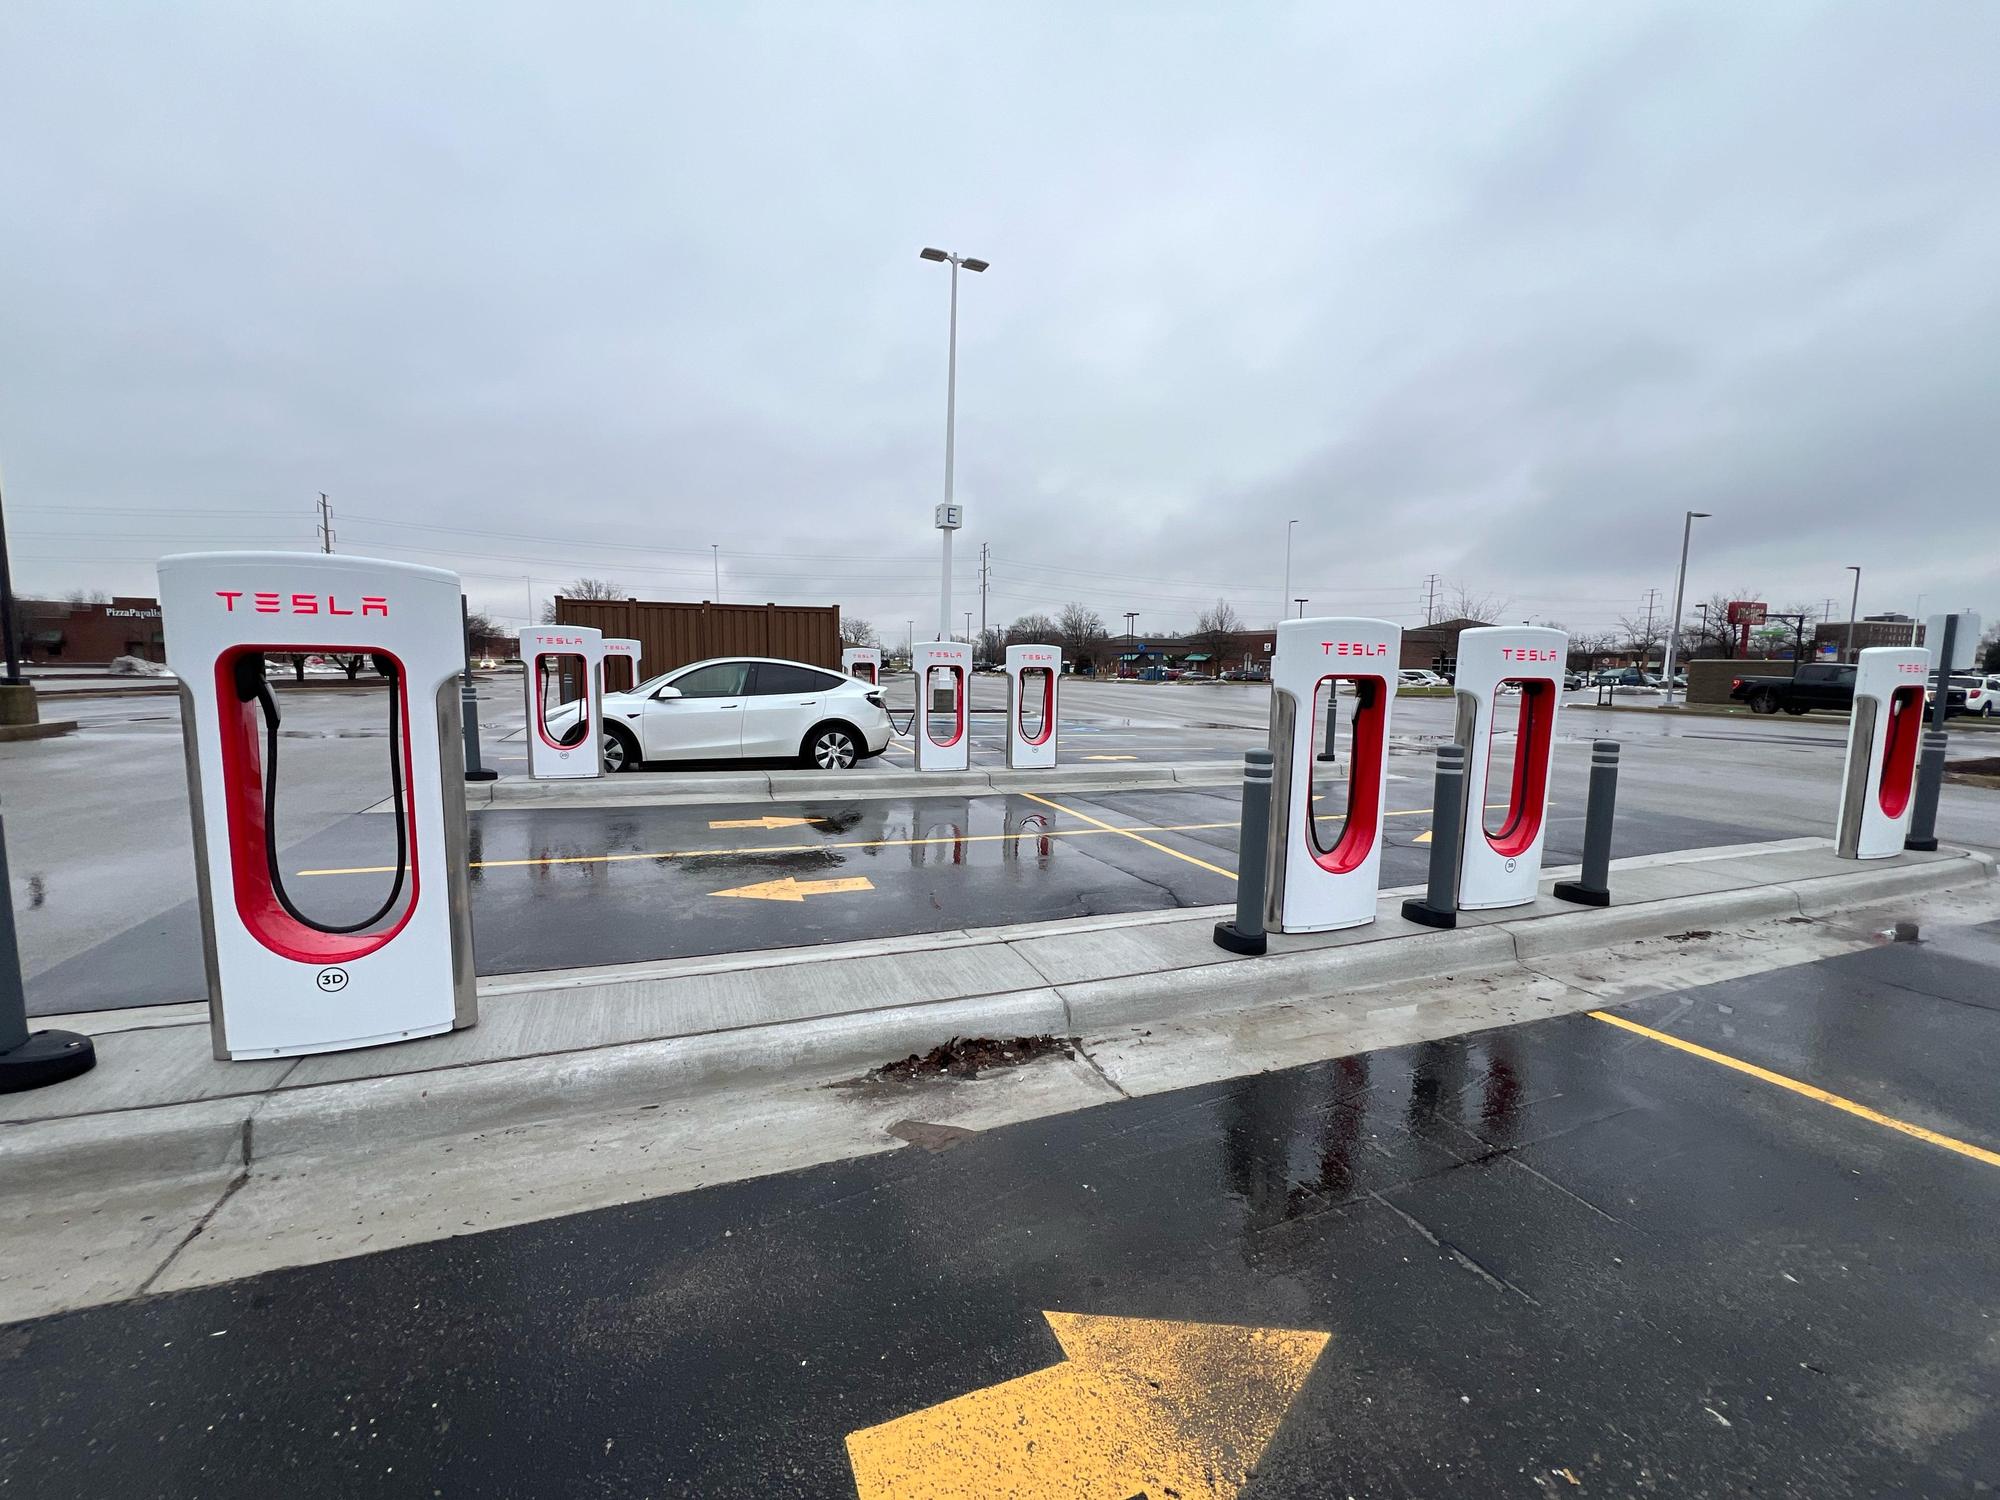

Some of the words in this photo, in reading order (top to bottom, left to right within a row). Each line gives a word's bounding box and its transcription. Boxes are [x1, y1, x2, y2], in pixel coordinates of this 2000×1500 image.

[948, 508, 957, 523] E
[216, 592, 388, 616] TESLA
[536, 637, 583, 645] TESLA
[1321, 643, 1386, 656] TESLA
[1502, 649, 1557, 661] TESLA
[322, 974, 343, 984] 3D
